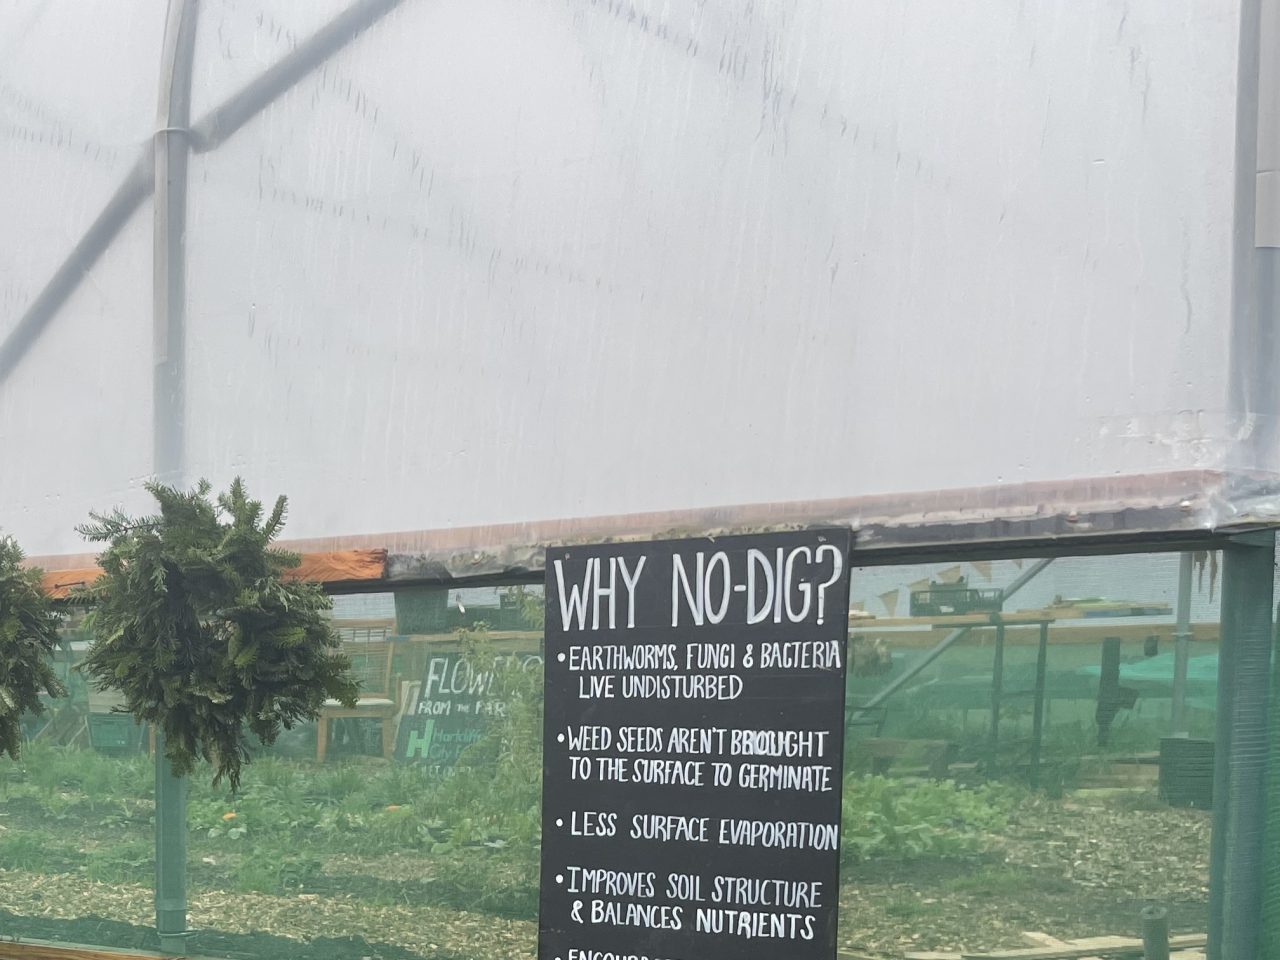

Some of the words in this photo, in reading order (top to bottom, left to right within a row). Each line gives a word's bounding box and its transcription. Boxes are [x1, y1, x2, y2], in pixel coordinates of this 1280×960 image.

[553, 555, 647, 632] WHY
[671, 544, 843, 628] NO-DIG?
[568, 643, 679, 671] EARTHWORMS,
[686, 642, 735, 671] FUNGI
[742, 643, 754, 669] &
[759, 639, 842, 670] BACTERIA
[578, 674, 616, 700] LIVE
[622, 674, 744, 701] UNDISTURBED
[418, 700, 451, 716] FROM
[475, 701, 507, 717] FAR
[567, 725, 612, 752] WEED
[616, 726, 664, 753] SEEDS
[666, 726, 728, 755] AREN'T
[568, 755, 592, 781] TO
[595, 757, 629, 783] THE
[631, 758, 706, 787] SURFACE
[710, 762, 733, 787] TO
[738, 762, 833, 793] GERMINATE
[571, 810, 618, 837] LESS
[629, 814, 710, 842] SURFACE
[718, 818, 839, 851] EVAPORATION
[566, 866, 656, 898] IMPROVES
[665, 872, 706, 902] SOIL
[711, 875, 823, 909] STRUCTURE
[570, 899, 584, 924] &
[590, 899, 684, 931] BALANCES
[696, 908, 816, 940] NUTRIENTS
